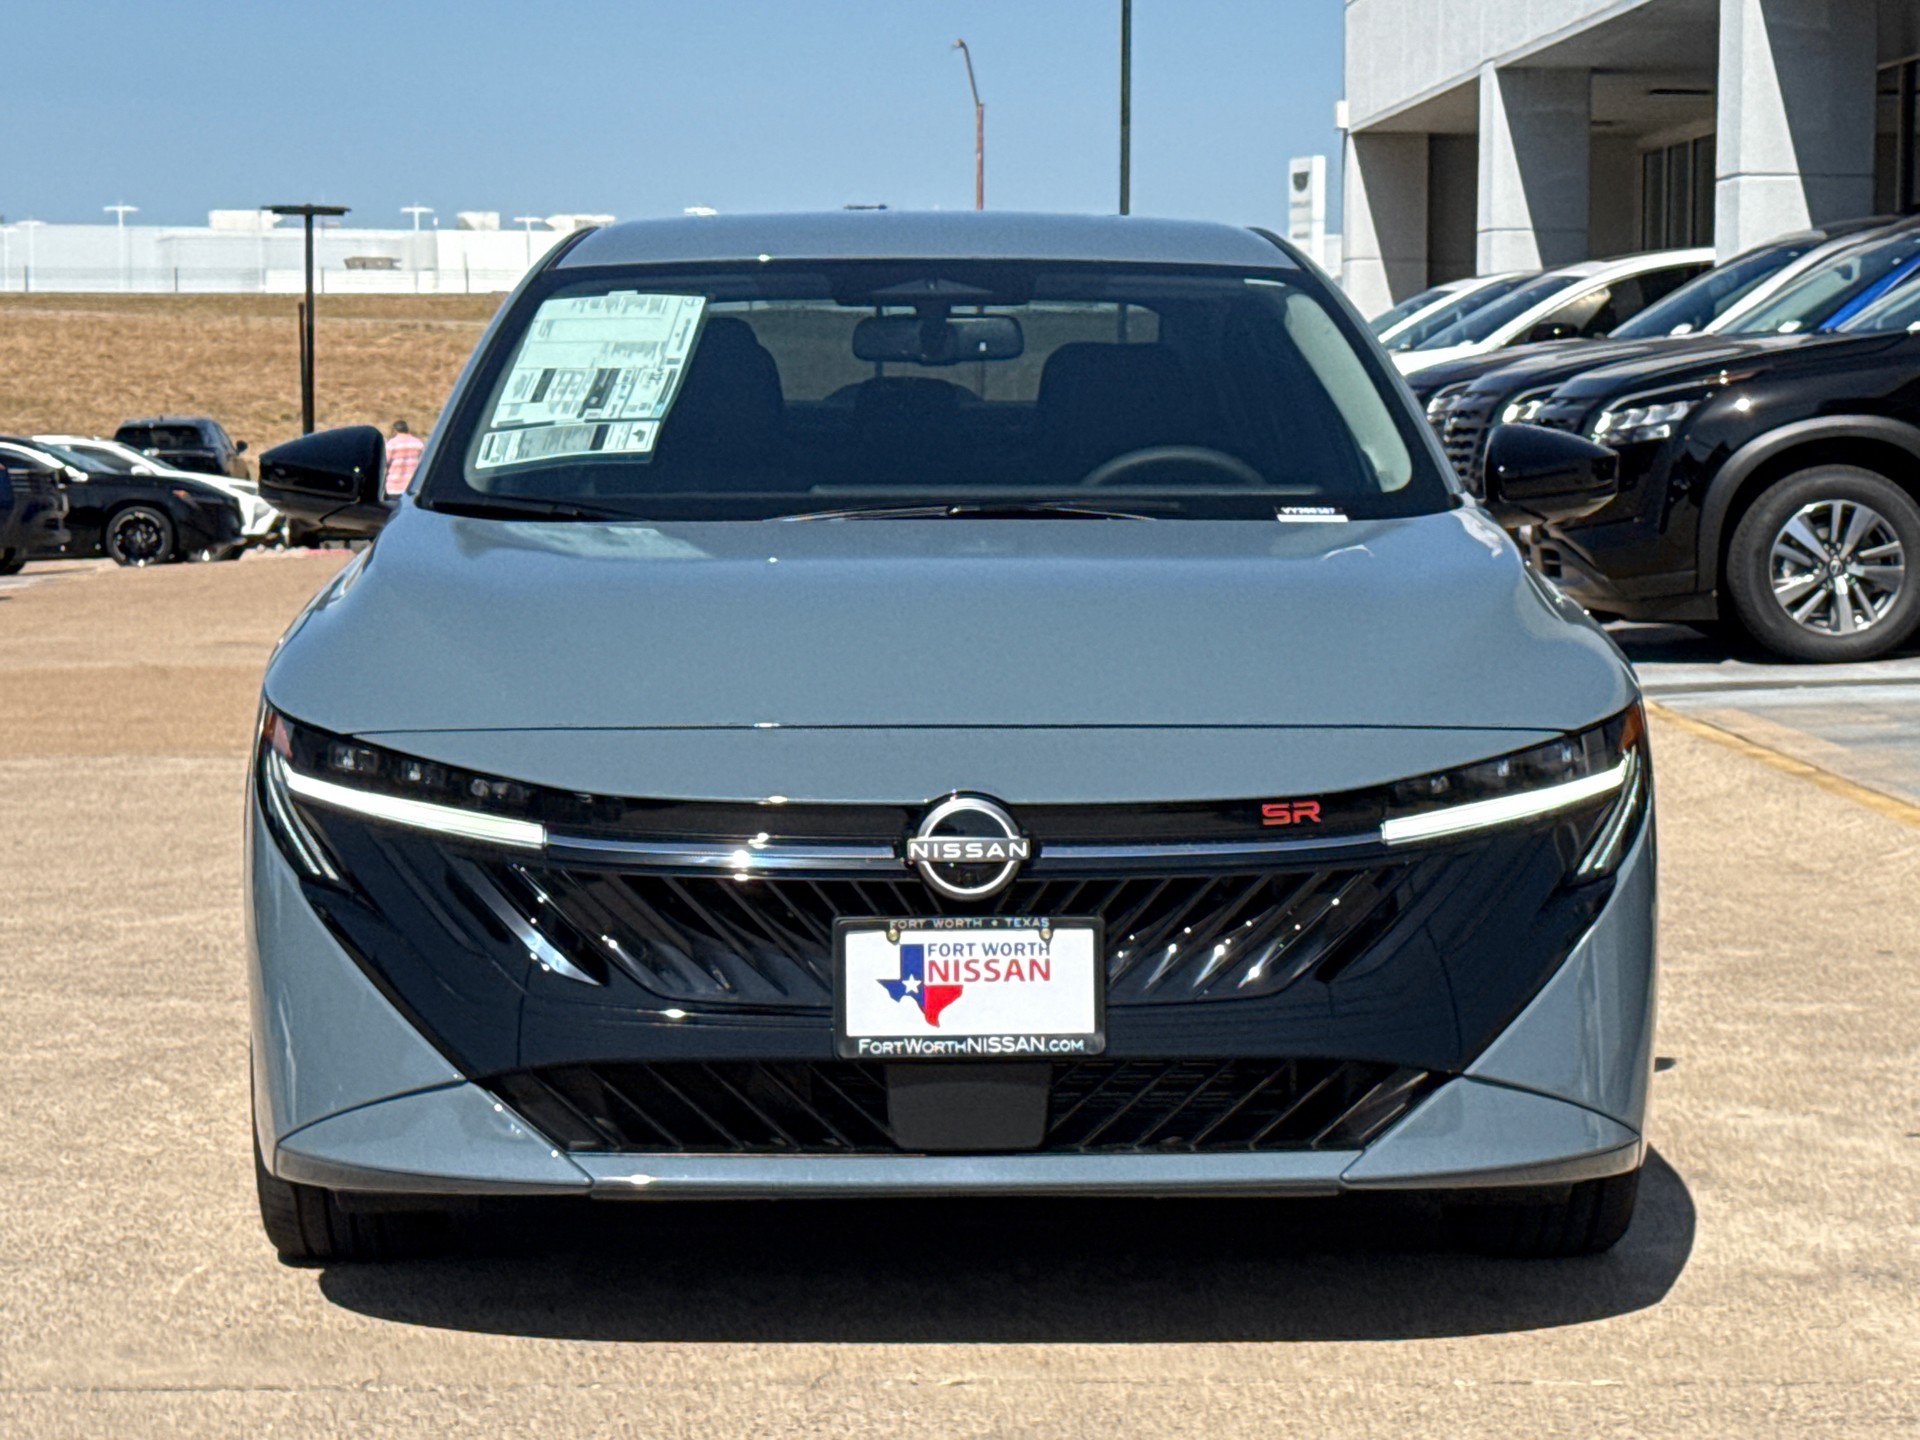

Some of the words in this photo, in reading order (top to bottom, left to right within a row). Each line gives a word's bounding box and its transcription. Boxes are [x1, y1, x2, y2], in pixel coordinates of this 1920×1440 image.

[1262, 801, 1321, 826] SR
[909, 842, 1028, 858] NISSAN
[889, 919, 925, 930] FORT
[933, 918, 982, 929] WORTH
[1005, 917, 1050, 928] TEXAS
[928, 943, 976, 957] FORT
[982, 942, 1050, 956] WORTH
[928, 958, 1051, 982] NISSAN
